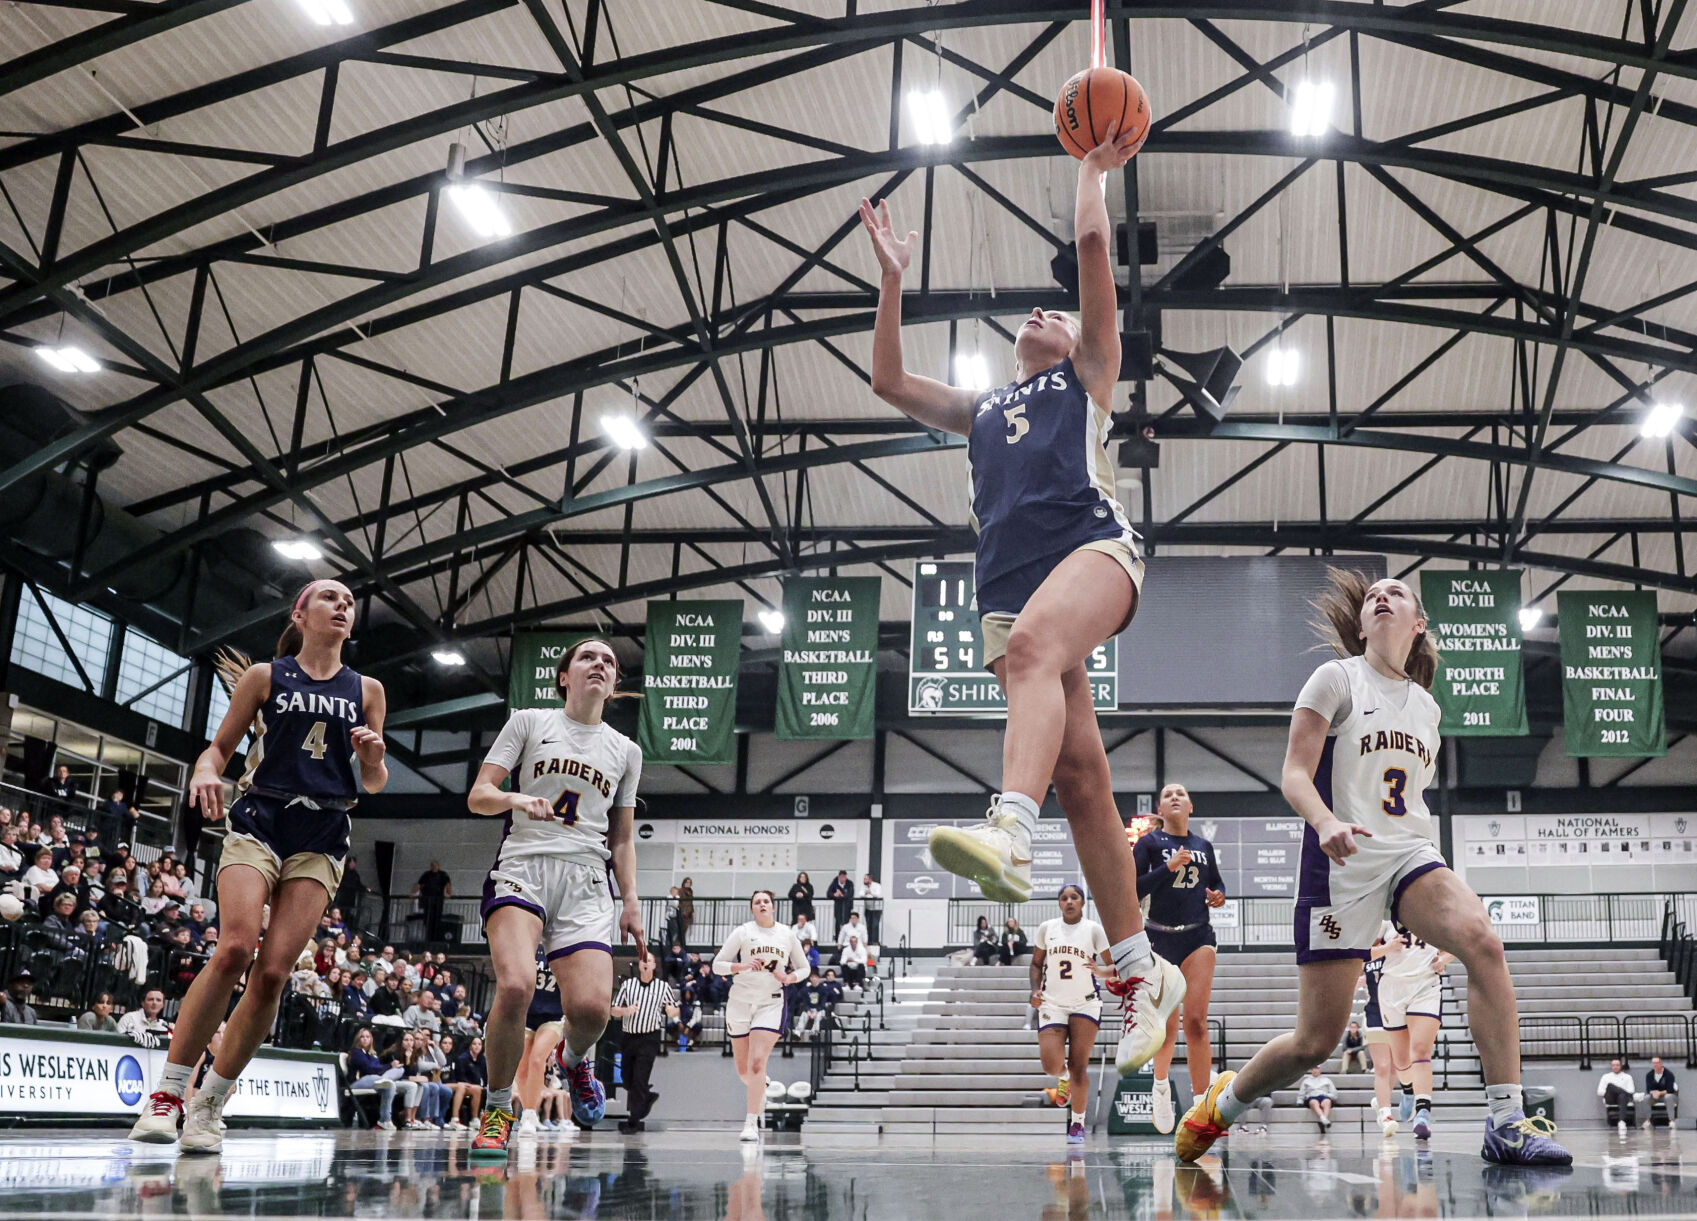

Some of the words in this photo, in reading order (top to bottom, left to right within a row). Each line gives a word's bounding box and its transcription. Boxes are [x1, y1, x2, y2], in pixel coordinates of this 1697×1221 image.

[1003, 403, 1030, 444] 5
[939, 579, 965, 606] 11
[1451, 580, 1490, 593] NCAA
[811, 589, 851, 602] NCAA
[1448, 594, 1475, 607] DIV.
[1479, 594, 1495, 607] III
[807, 609, 833, 622] DIV.
[836, 609, 852, 622] III
[1588, 605, 1629, 618] NCAA
[675, 614, 714, 627] NCAA
[807, 630, 850, 643] MEN'S
[1439, 623, 1507, 636] WOMEN'S
[1586, 625, 1614, 638] DIV.
[1616, 625, 1632, 638] III
[670, 634, 697, 647] DIV.
[699, 634, 715, 647] III
[540, 646, 567, 659] NCA
[784, 650, 873, 664] BASKETBALL
[934, 646, 949, 669] 5
[958, 647, 974, 669] 4
[1588, 645, 1632, 659] MEN'S
[670, 655, 712, 668] MEN'S
[535, 666, 557, 679] DIV
[802, 671, 847, 684] THIRD
[1445, 667, 1505, 681] FOURTH
[1565, 666, 1658, 680] BASKETBALL
[644, 675, 733, 688] BASKETBALL
[1452, 681, 1500, 695] PLACE
[802, 691, 848, 705] PLACE
[948, 684, 1006, 702] SHIR
[1592, 687, 1635, 701] FINAL
[276, 691, 358, 723] SAINTS
[664, 696, 708, 709] THIRD
[810, 712, 839, 726] 2006
[1463, 712, 1490, 726] 2011
[1594, 708, 1634, 722] FOUR
[662, 716, 708, 730] PLACE
[301, 721, 328, 760] 4
[670, 737, 697, 751] 2001
[1600, 730, 1630, 744] 2012
[533, 757, 611, 799] RAIDERS
[1382, 766, 1408, 818] 3
[552, 788, 582, 827] 4
[796, 799, 807, 813] G
[1139, 799, 1149, 812] H
[1557, 818, 1619, 827] NATIONAL
[683, 825, 739, 835] NATIONAL
[744, 825, 790, 835] HONORS
[1538, 828, 1569, 838] HALL
[1574, 828, 1590, 837] OF
[1595, 827, 1639, 837] FAMERS
[1161, 848, 1208, 866] SNTS
[1172, 865, 1200, 889] 23
[1509, 900, 1535, 909] TITAN
[1511, 911, 1535, 920] BAND
[1318, 914, 1342, 940] BHS
[750, 945, 785, 959] RAIDERS
[1059, 959, 1073, 980] 2
[1365, 960, 1382, 972] SAI
[536, 973, 557, 992] 32
[18, 1053, 109, 1081] WESLEYAN
[0, 1085, 73, 1100] IVERSITY
[117, 1079, 144, 1095] NCAA
[248, 1079, 270, 1096] THE
[274, 1081, 310, 1098] TITANS
[1123, 1094, 1153, 1104] ILLIN
[1119, 1104, 1153, 1114] WESLE
